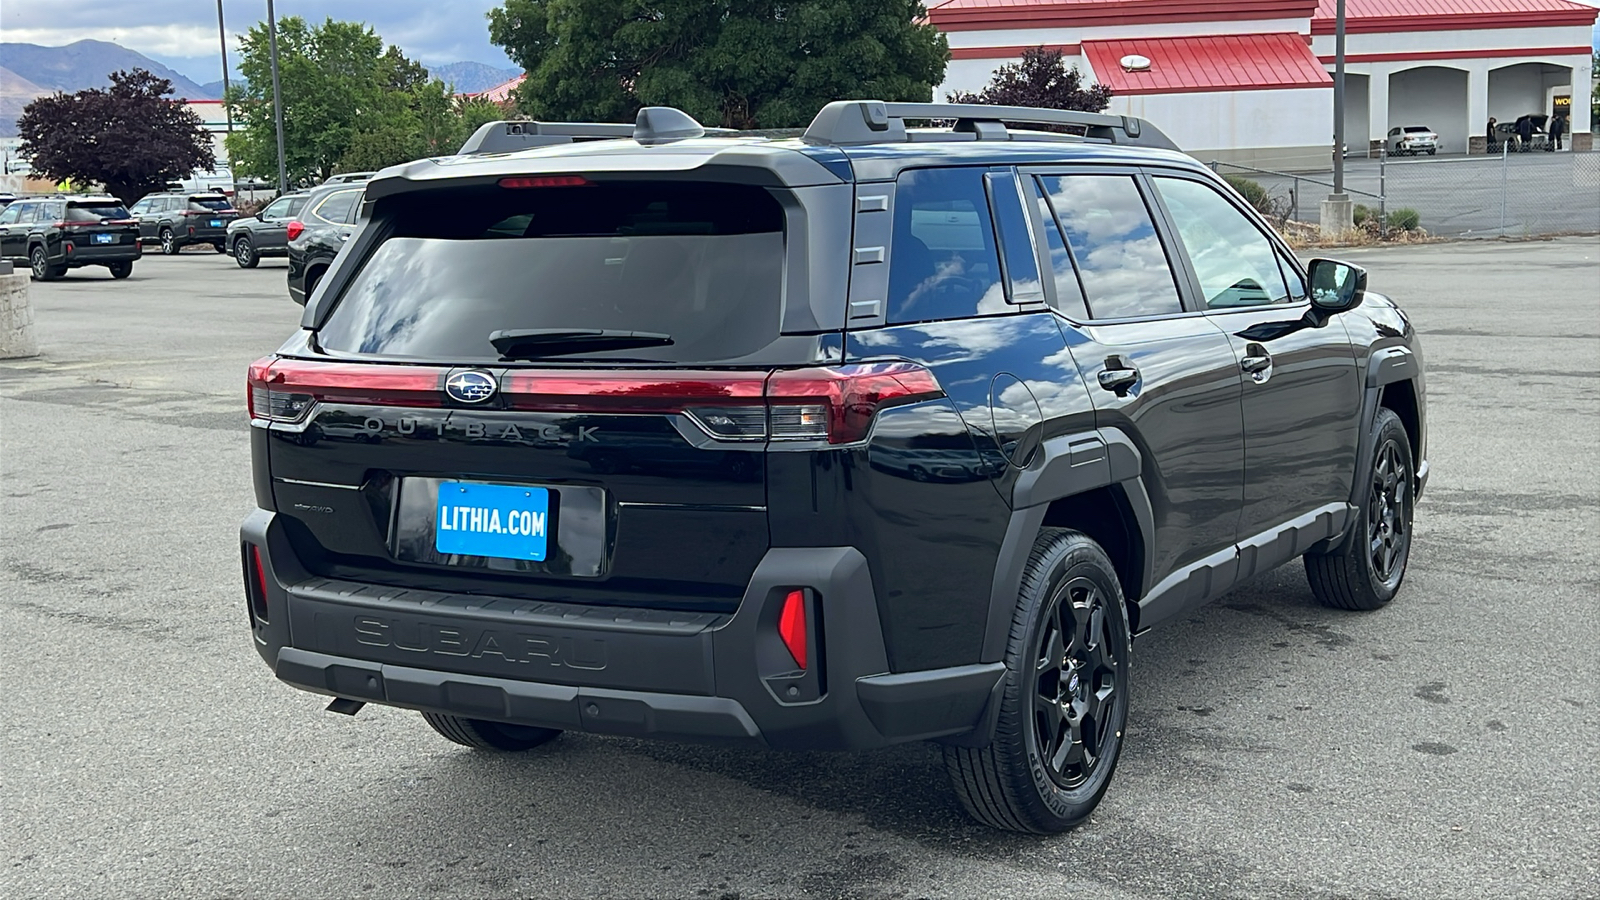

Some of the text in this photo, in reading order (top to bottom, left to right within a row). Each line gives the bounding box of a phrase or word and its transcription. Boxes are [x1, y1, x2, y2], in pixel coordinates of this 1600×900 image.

[363, 416, 600, 443] OUTBACK
[440, 505, 545, 537] LITHIA.COM
[353, 615, 608, 671] SUBARU
[1029, 752, 1067, 816] DUNLOP
